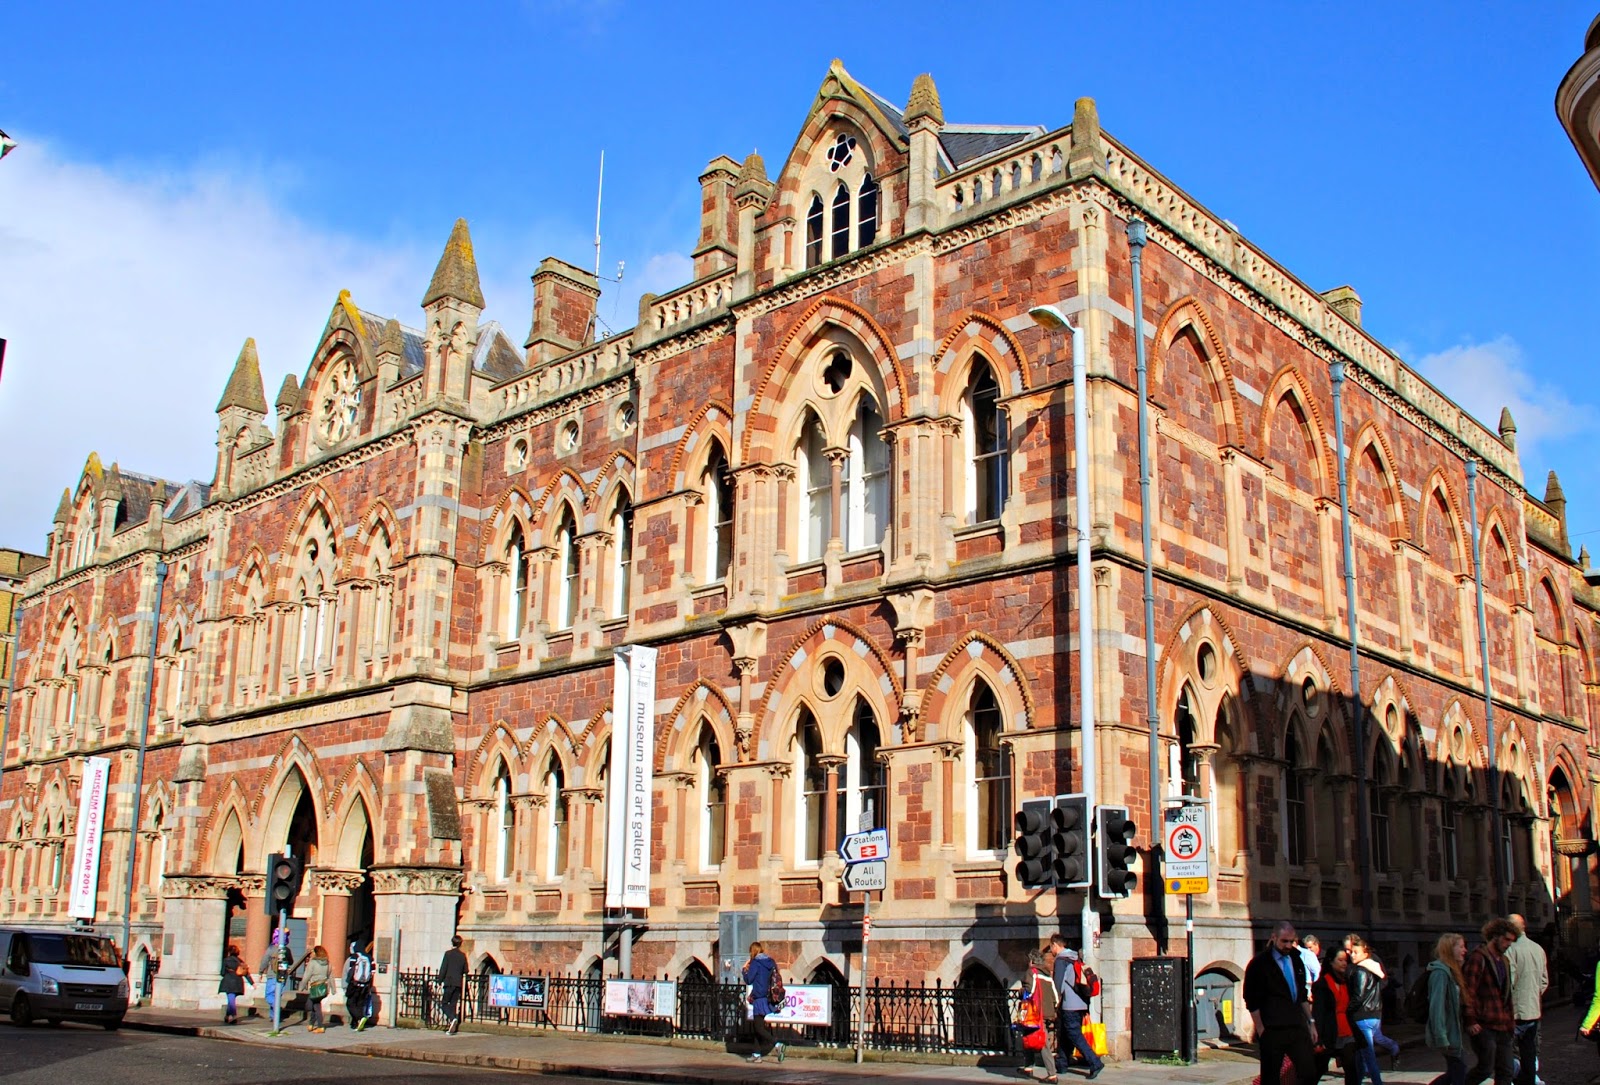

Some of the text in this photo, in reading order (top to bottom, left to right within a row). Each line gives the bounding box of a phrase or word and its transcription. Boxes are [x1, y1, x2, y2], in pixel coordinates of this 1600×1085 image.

[637, 679, 648, 688] free
[316, 701, 367, 717] MEMORIAL
[631, 702, 645, 871] museum and art gallery
[1172, 814, 1198, 823] ZONE
[82, 769, 102, 895] MUSEUM OF THE YEAR 2012
[854, 834, 884, 845] Stations
[863, 866, 874, 875] All
[855, 877, 883, 886] Routes
[627, 884, 647, 892] ramm
[522, 994, 543, 1002] TIMELESS
